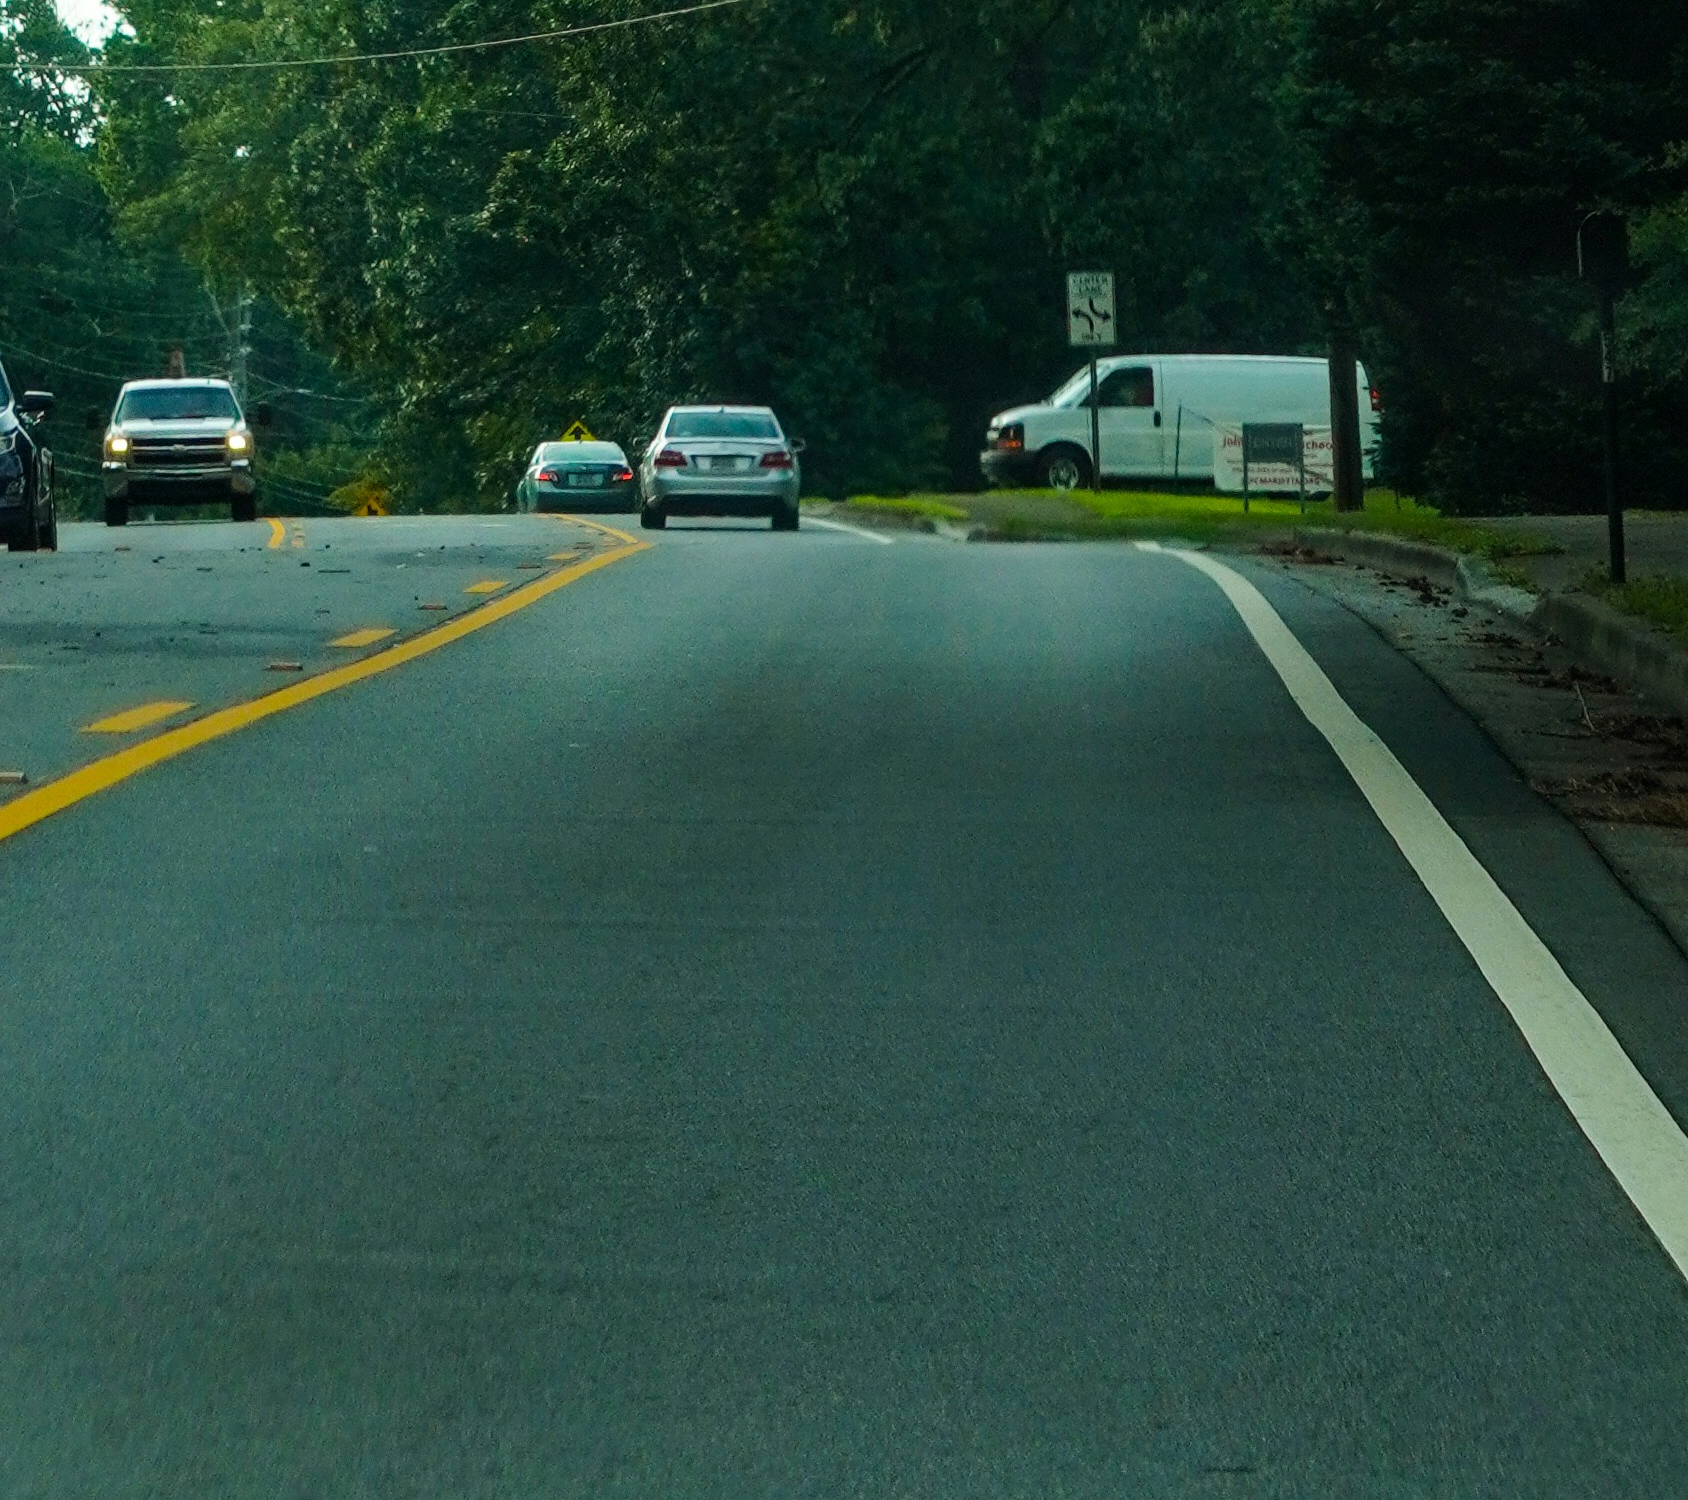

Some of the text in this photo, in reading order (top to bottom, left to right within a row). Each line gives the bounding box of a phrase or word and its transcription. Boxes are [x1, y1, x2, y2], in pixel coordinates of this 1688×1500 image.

[1072, 275, 1108, 285] CENTER
[1078, 285, 1102, 293] LANE
[1082, 332, 1102, 341] ONLY
